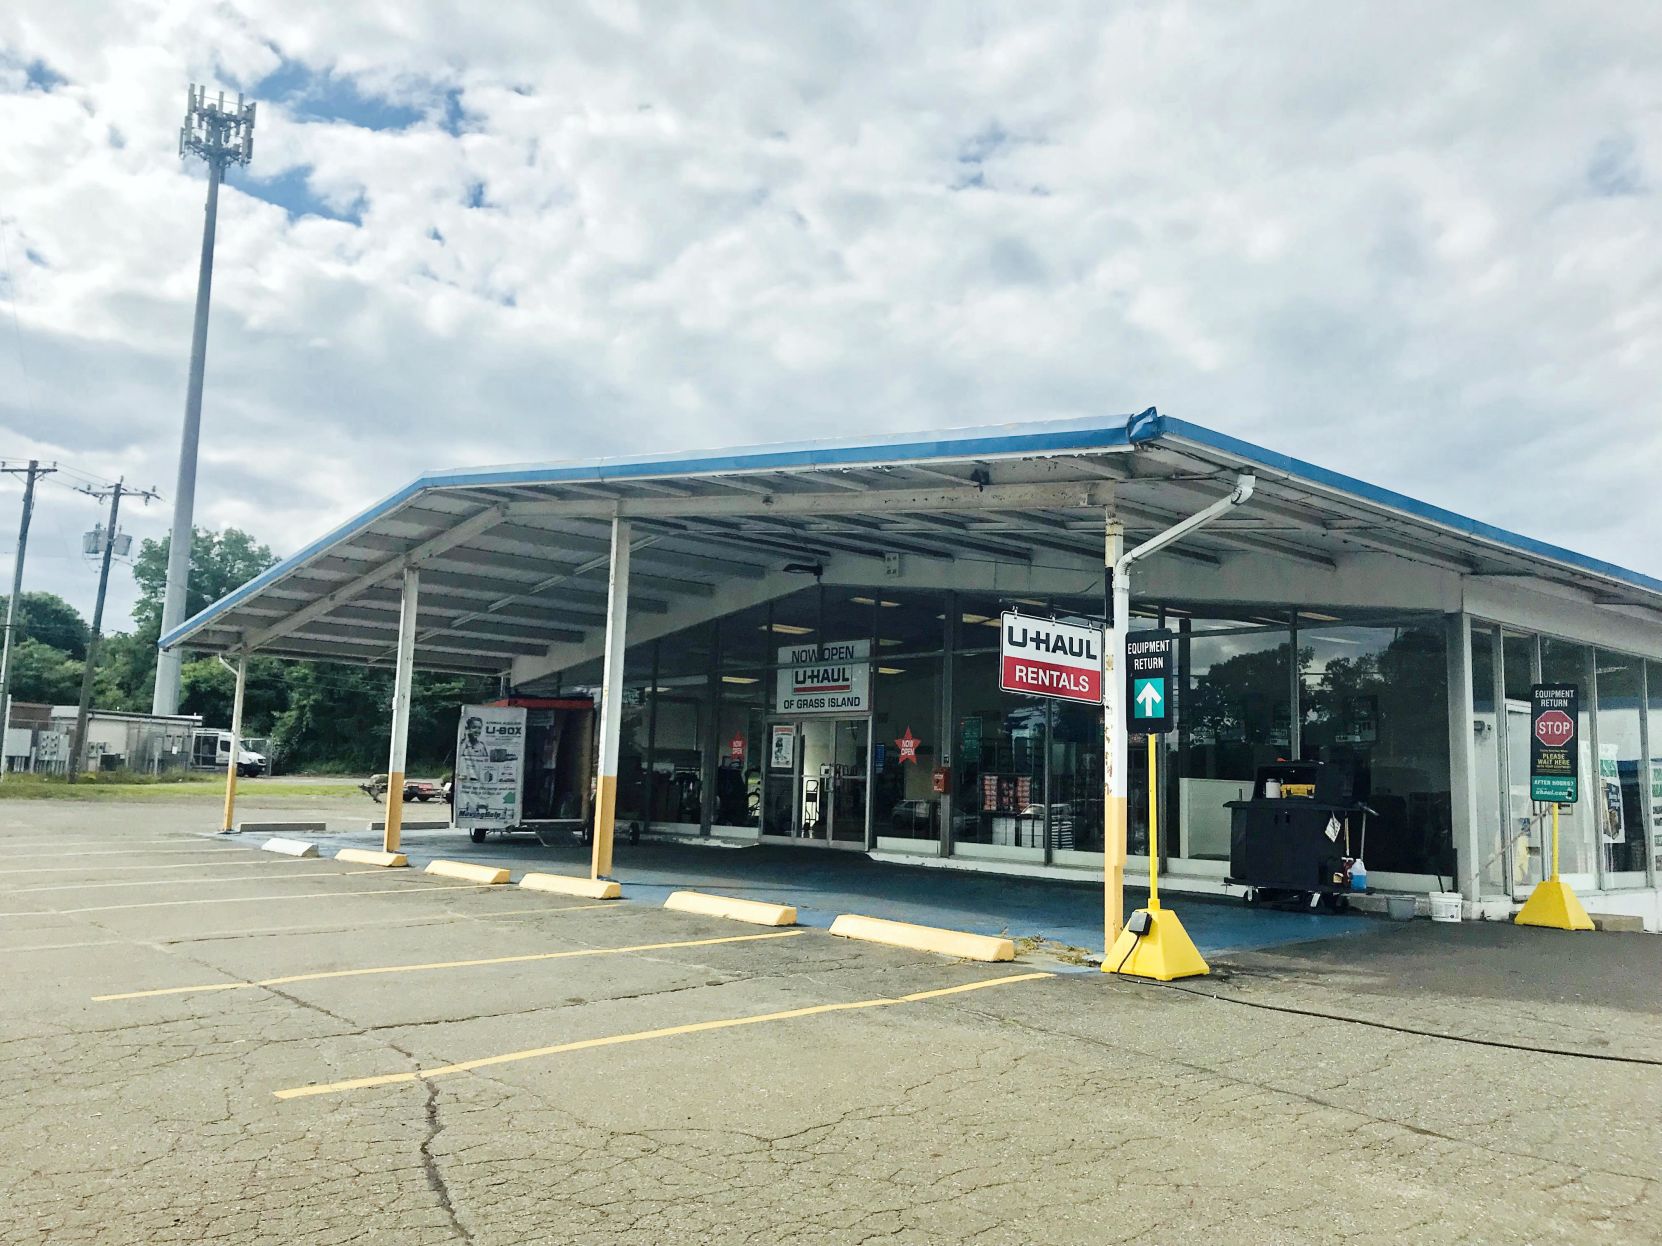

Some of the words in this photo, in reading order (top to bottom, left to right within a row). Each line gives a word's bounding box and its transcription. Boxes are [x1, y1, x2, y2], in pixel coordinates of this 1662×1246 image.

[1127, 639, 1170, 655] EQUIPMENT
[791, 648, 818, 663] NOW
[823, 645, 855, 661] OPEN
[1134, 656, 1164, 671] RETURN
[1015, 665, 1090, 693] RENTALS
[1535, 689, 1575, 699] EQUIPMENT
[783, 699, 795, 709] OF
[796, 698, 826, 709] GRASS
[828, 696, 861, 708] ISLAND
[1540, 698, 1568, 707] RETURN
[1538, 721, 1571, 735] STOP
[901, 740, 914, 748] NOW
[900, 748, 915, 756] OPEN
